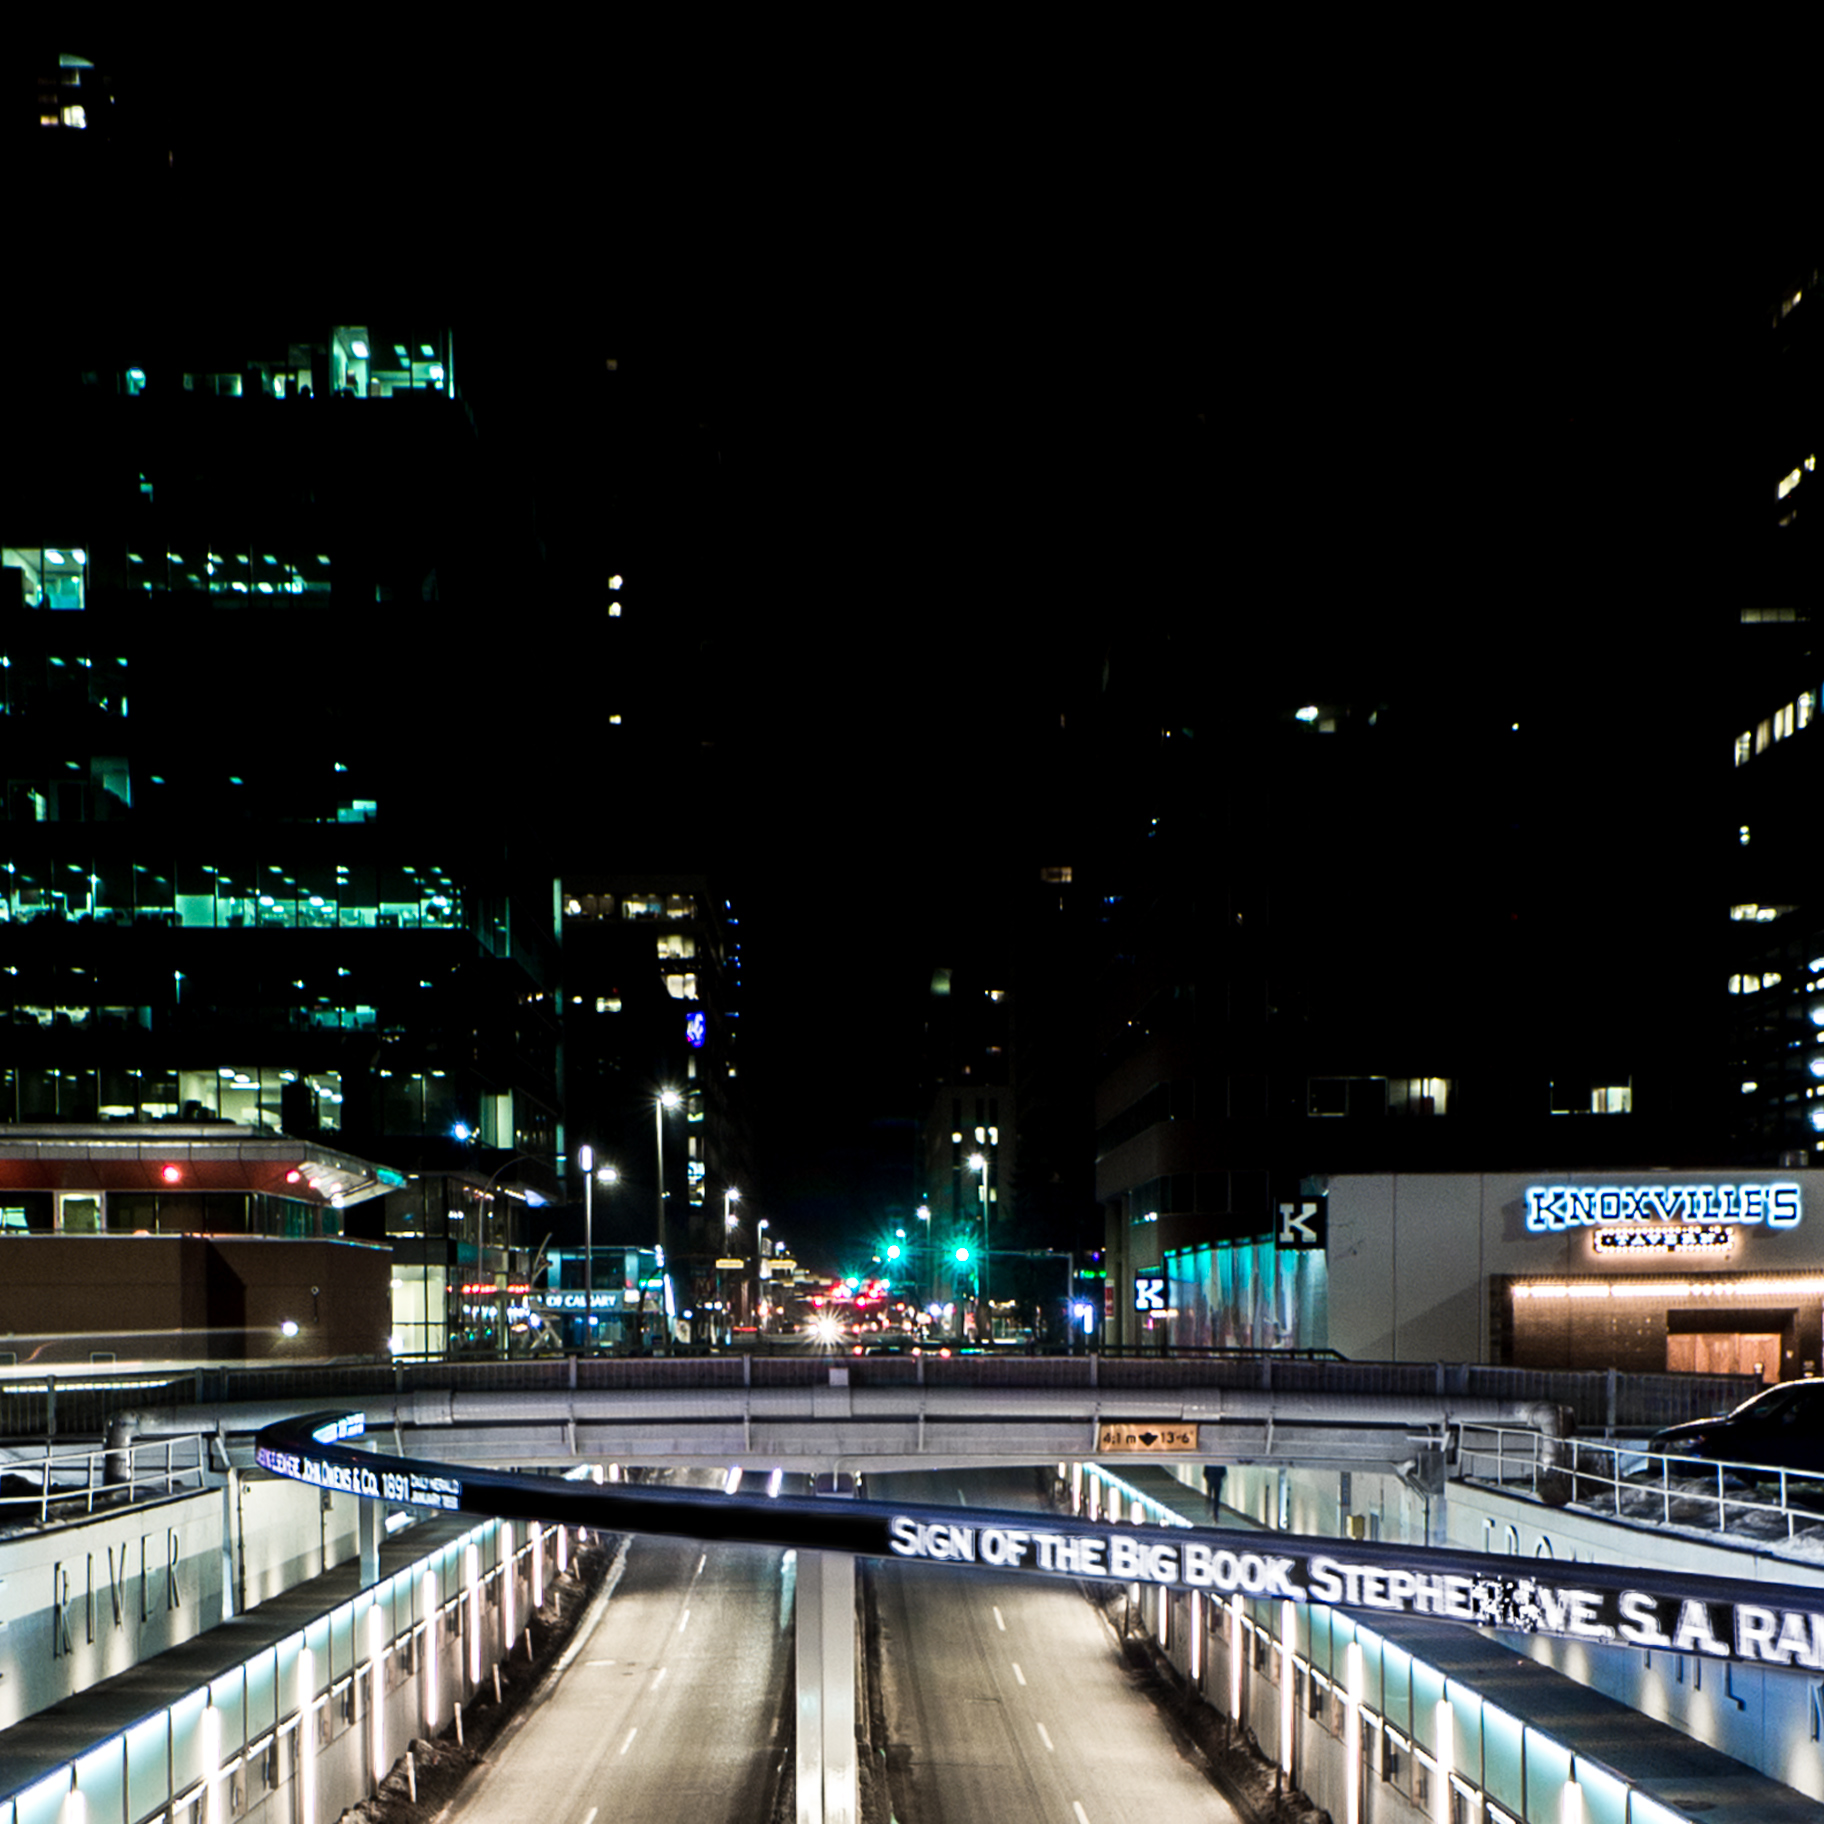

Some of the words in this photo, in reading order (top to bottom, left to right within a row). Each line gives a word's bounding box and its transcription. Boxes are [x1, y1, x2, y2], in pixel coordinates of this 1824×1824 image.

[1279, 1203, 1317, 1243] K
[1526, 1184, 1803, 1231] KNOXVILLE'S
[1614, 1232, 1716, 1247] TAVERN
[564, 1294, 616, 1309] CALARY
[1135, 1279, 1165, 1310] K
[1126, 1434, 1136, 1444] m
[890, 1515, 976, 1562] SIGN
[979, 1528, 1029, 1567] OF
[1031, 1533, 1107, 1573] THE
[1107, 1534, 1179, 1583] BIG
[53, 1527, 181, 1659] RIVER
